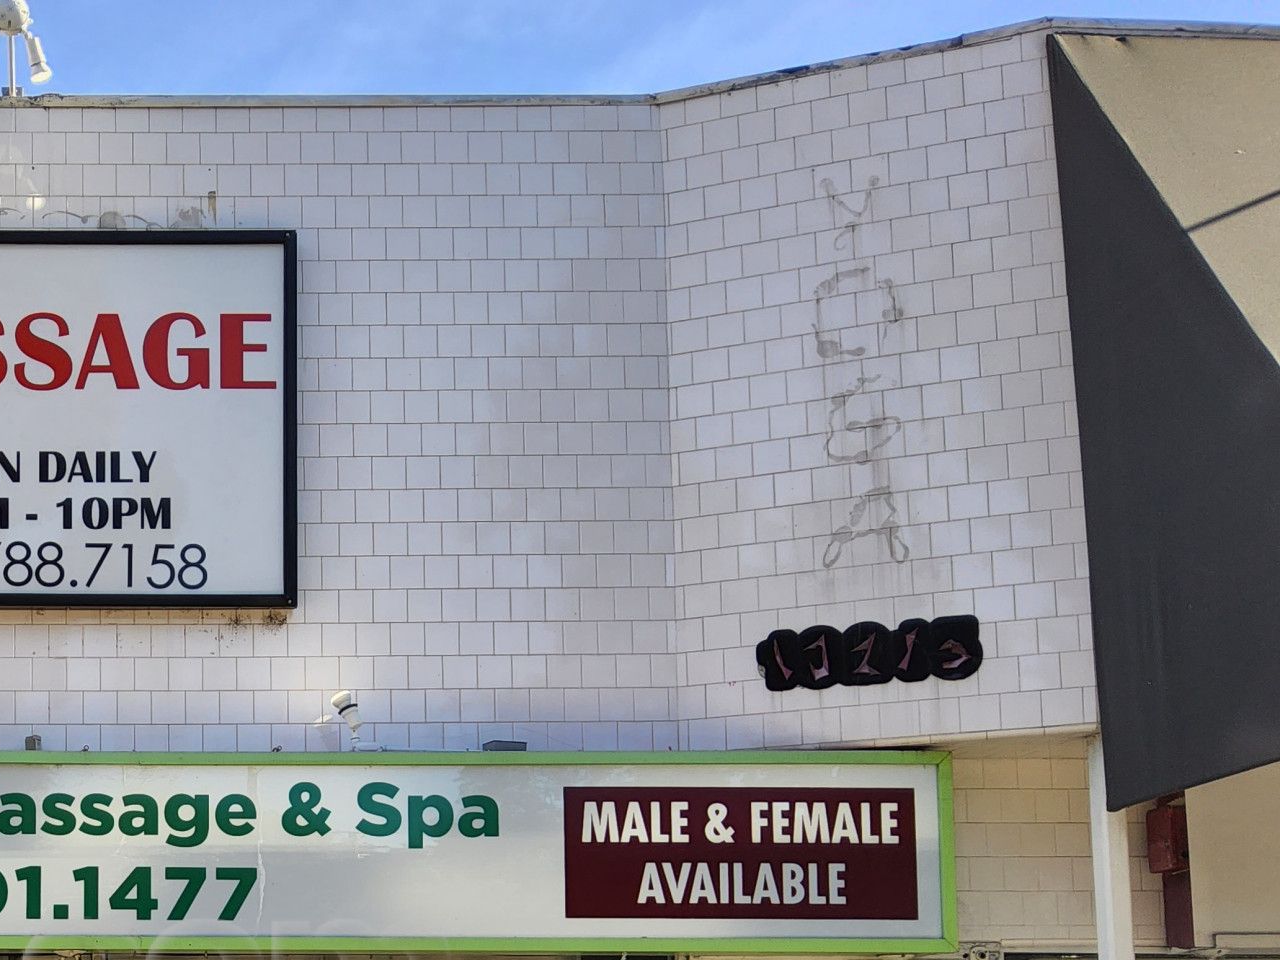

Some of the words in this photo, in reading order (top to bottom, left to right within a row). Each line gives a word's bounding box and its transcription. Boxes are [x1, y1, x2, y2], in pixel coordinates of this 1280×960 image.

[38, 450, 158, 484] DAILY
[26, 512, 38, 521] -
[56, 497, 172, 531] 10PM
[281, 781, 332, 839] &
[355, 781, 501, 849] Spa
[582, 801, 690, 844] MALE
[705, 802, 736, 843] &
[751, 801, 900, 845] FEMALE
[637, 862, 847, 905] AVAILABLE
